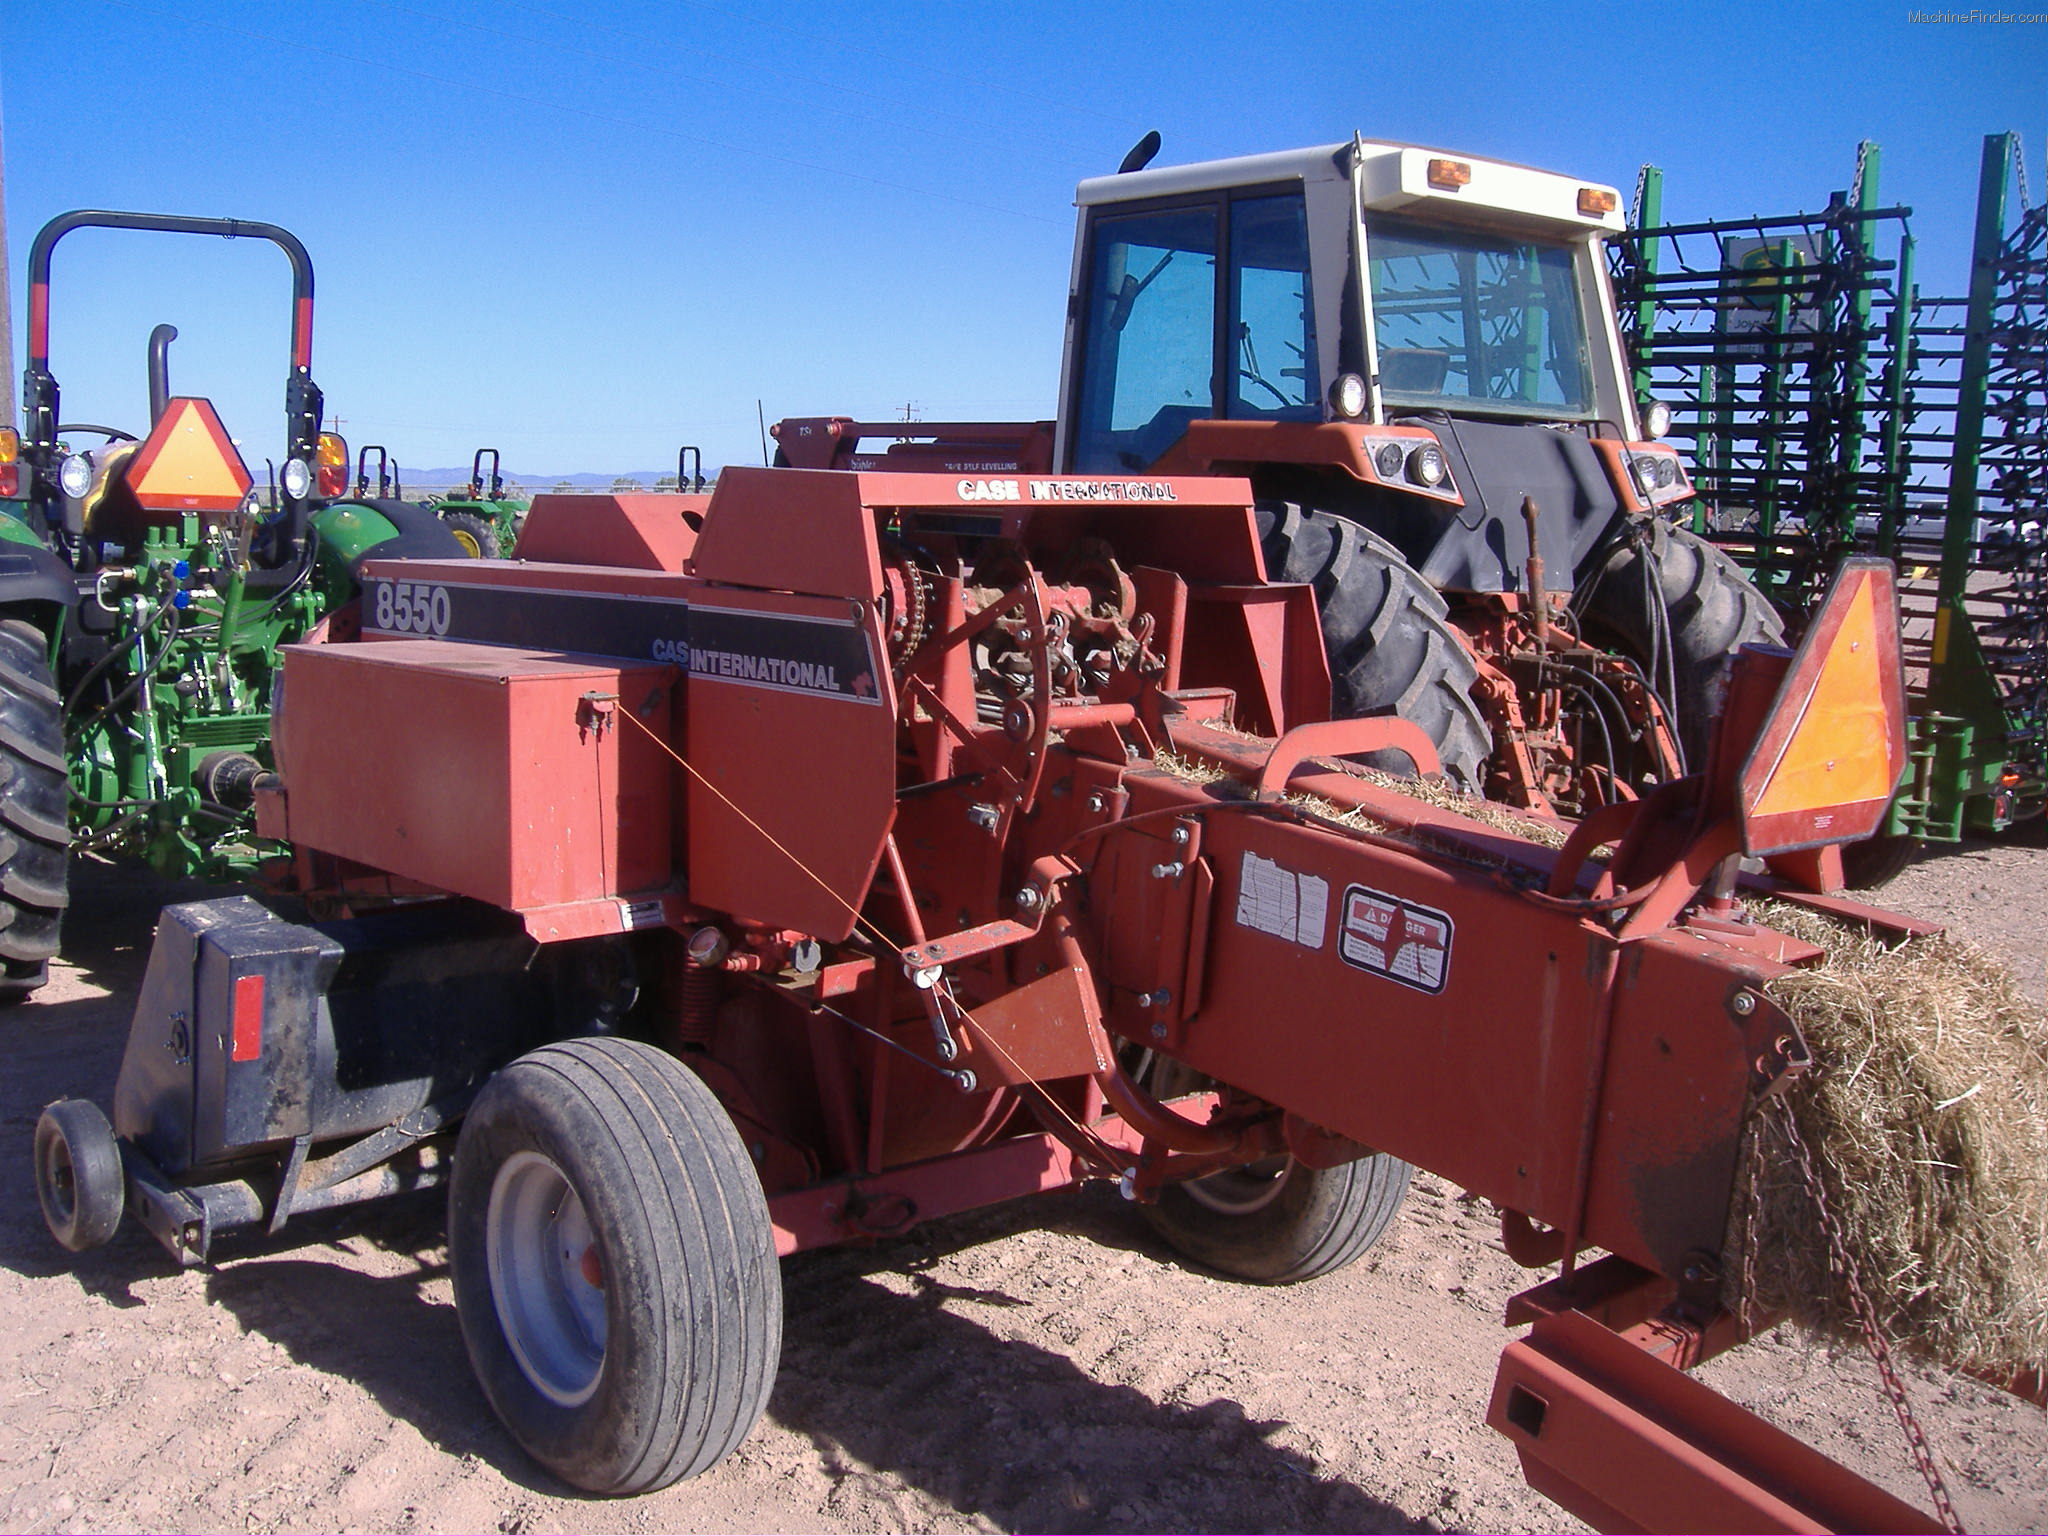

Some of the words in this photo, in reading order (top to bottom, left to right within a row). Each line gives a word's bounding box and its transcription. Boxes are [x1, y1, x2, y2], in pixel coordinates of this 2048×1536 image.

[981, 462, 1018, 471] LEVELLING
[956, 479, 1021, 501] CASE
[1030, 480, 1178, 502] INTERNATIONAL
[376, 582, 451, 636] 8550
[652, 638, 689, 664] CAS
[690, 648, 840, 691] INTERNATIONAL
[1380, 912, 1426, 937] DGER
